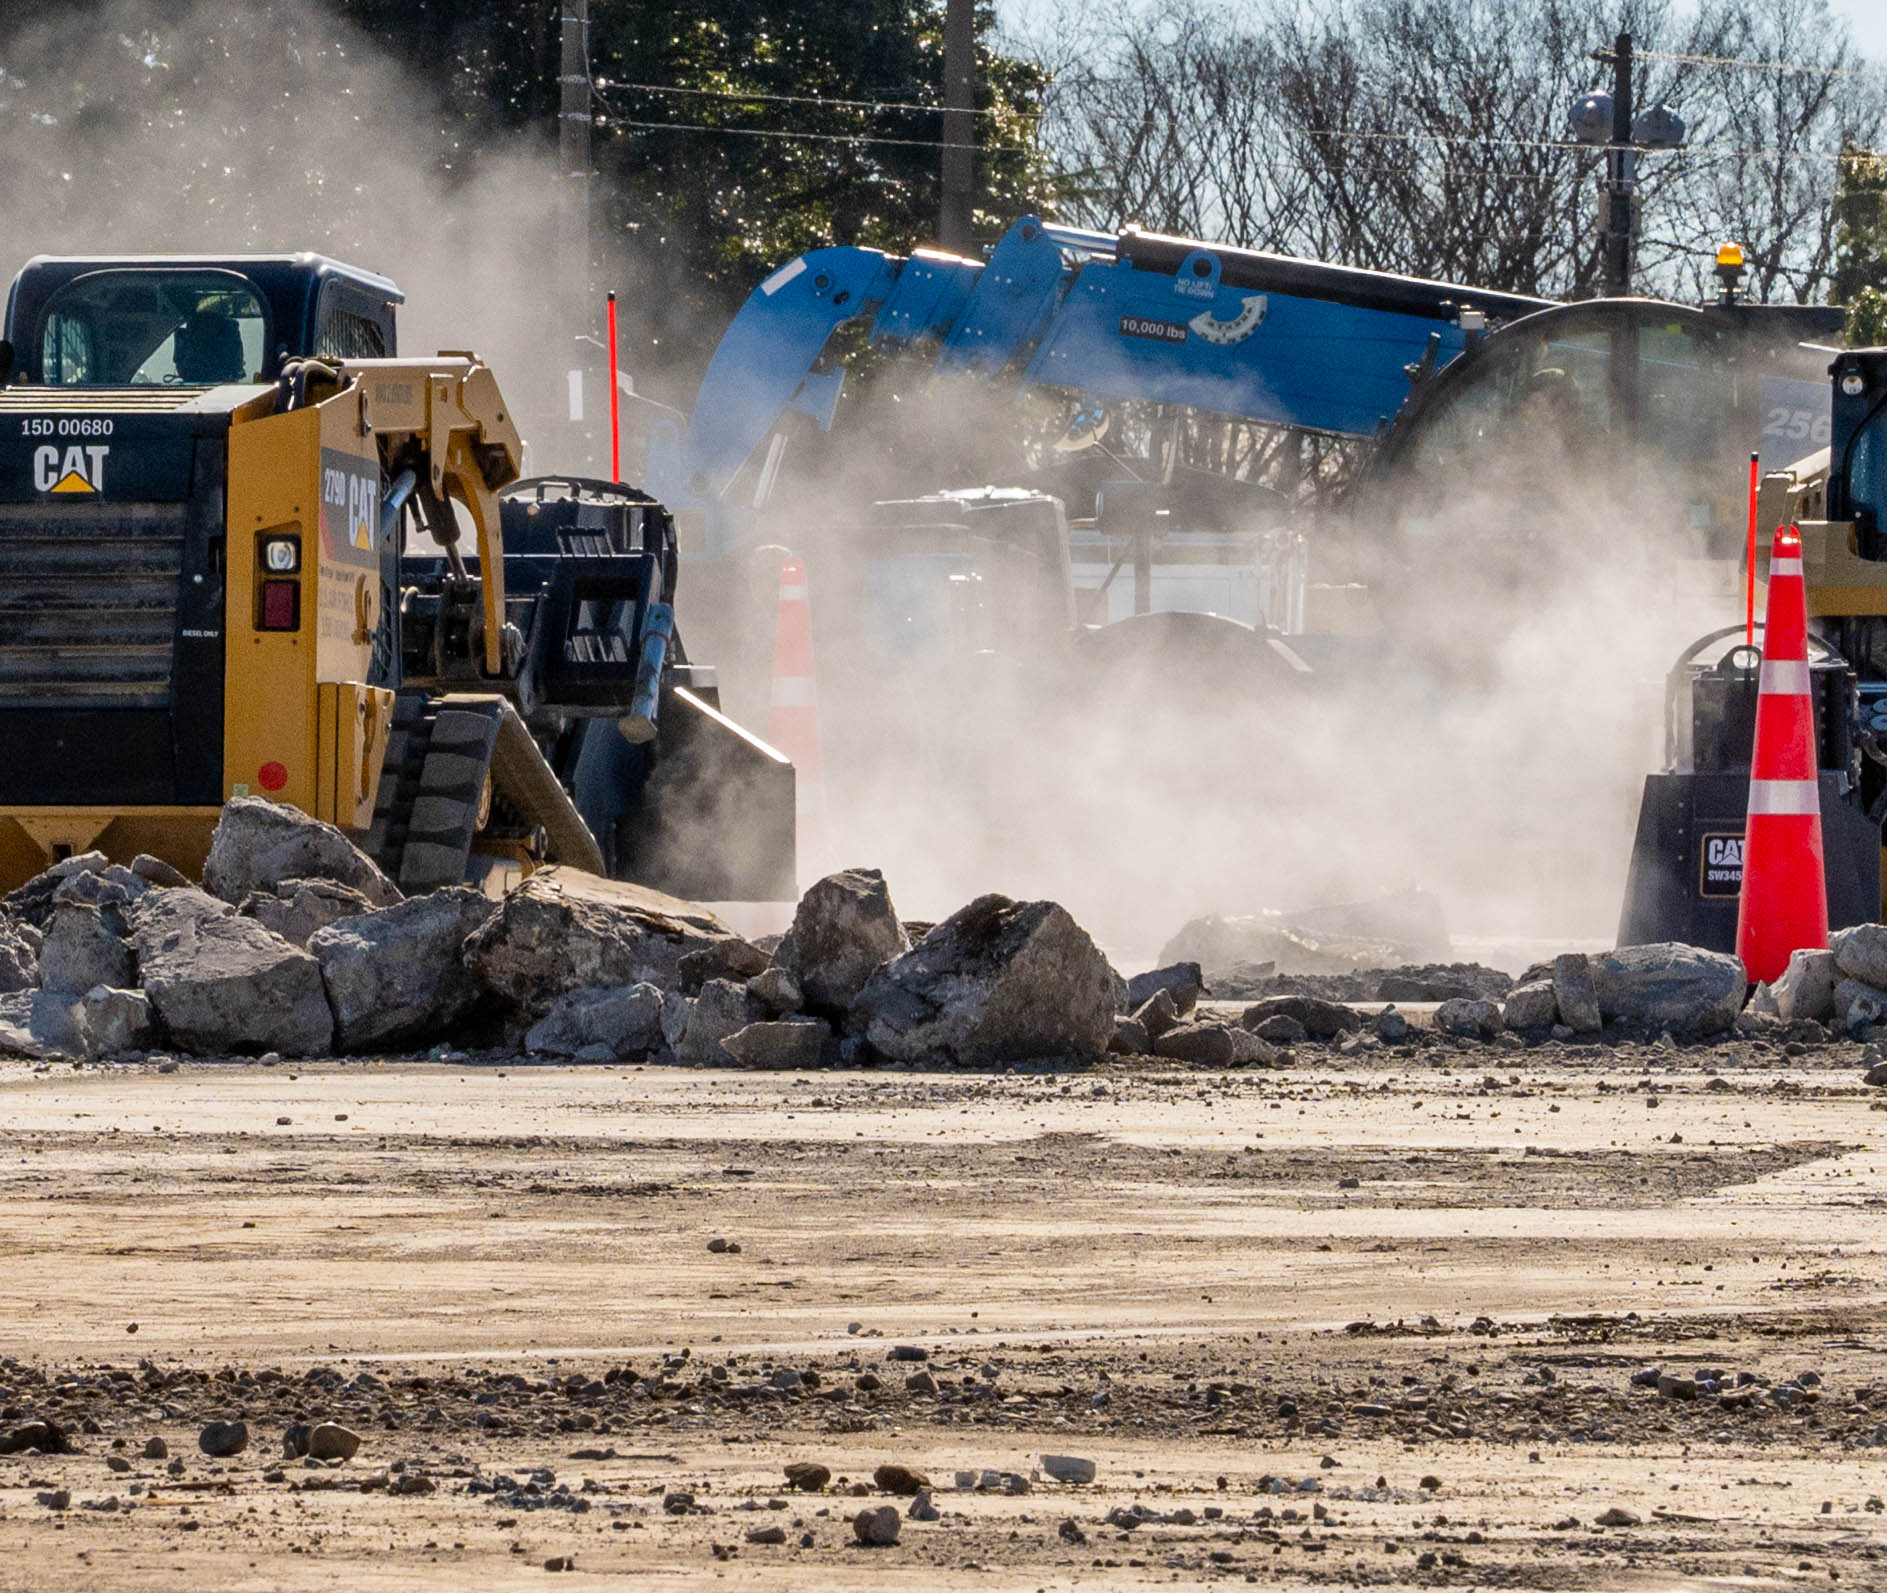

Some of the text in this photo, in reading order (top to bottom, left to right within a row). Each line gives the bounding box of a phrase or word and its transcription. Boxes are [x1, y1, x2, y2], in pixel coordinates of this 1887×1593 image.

[1121, 319, 1187, 339] 10,000 lbs
[21, 419, 114, 435] 15D 00680
[33, 445, 110, 492] CAT
[348, 473, 377, 551] CAT
[1707, 869, 1742, 881] SW345
